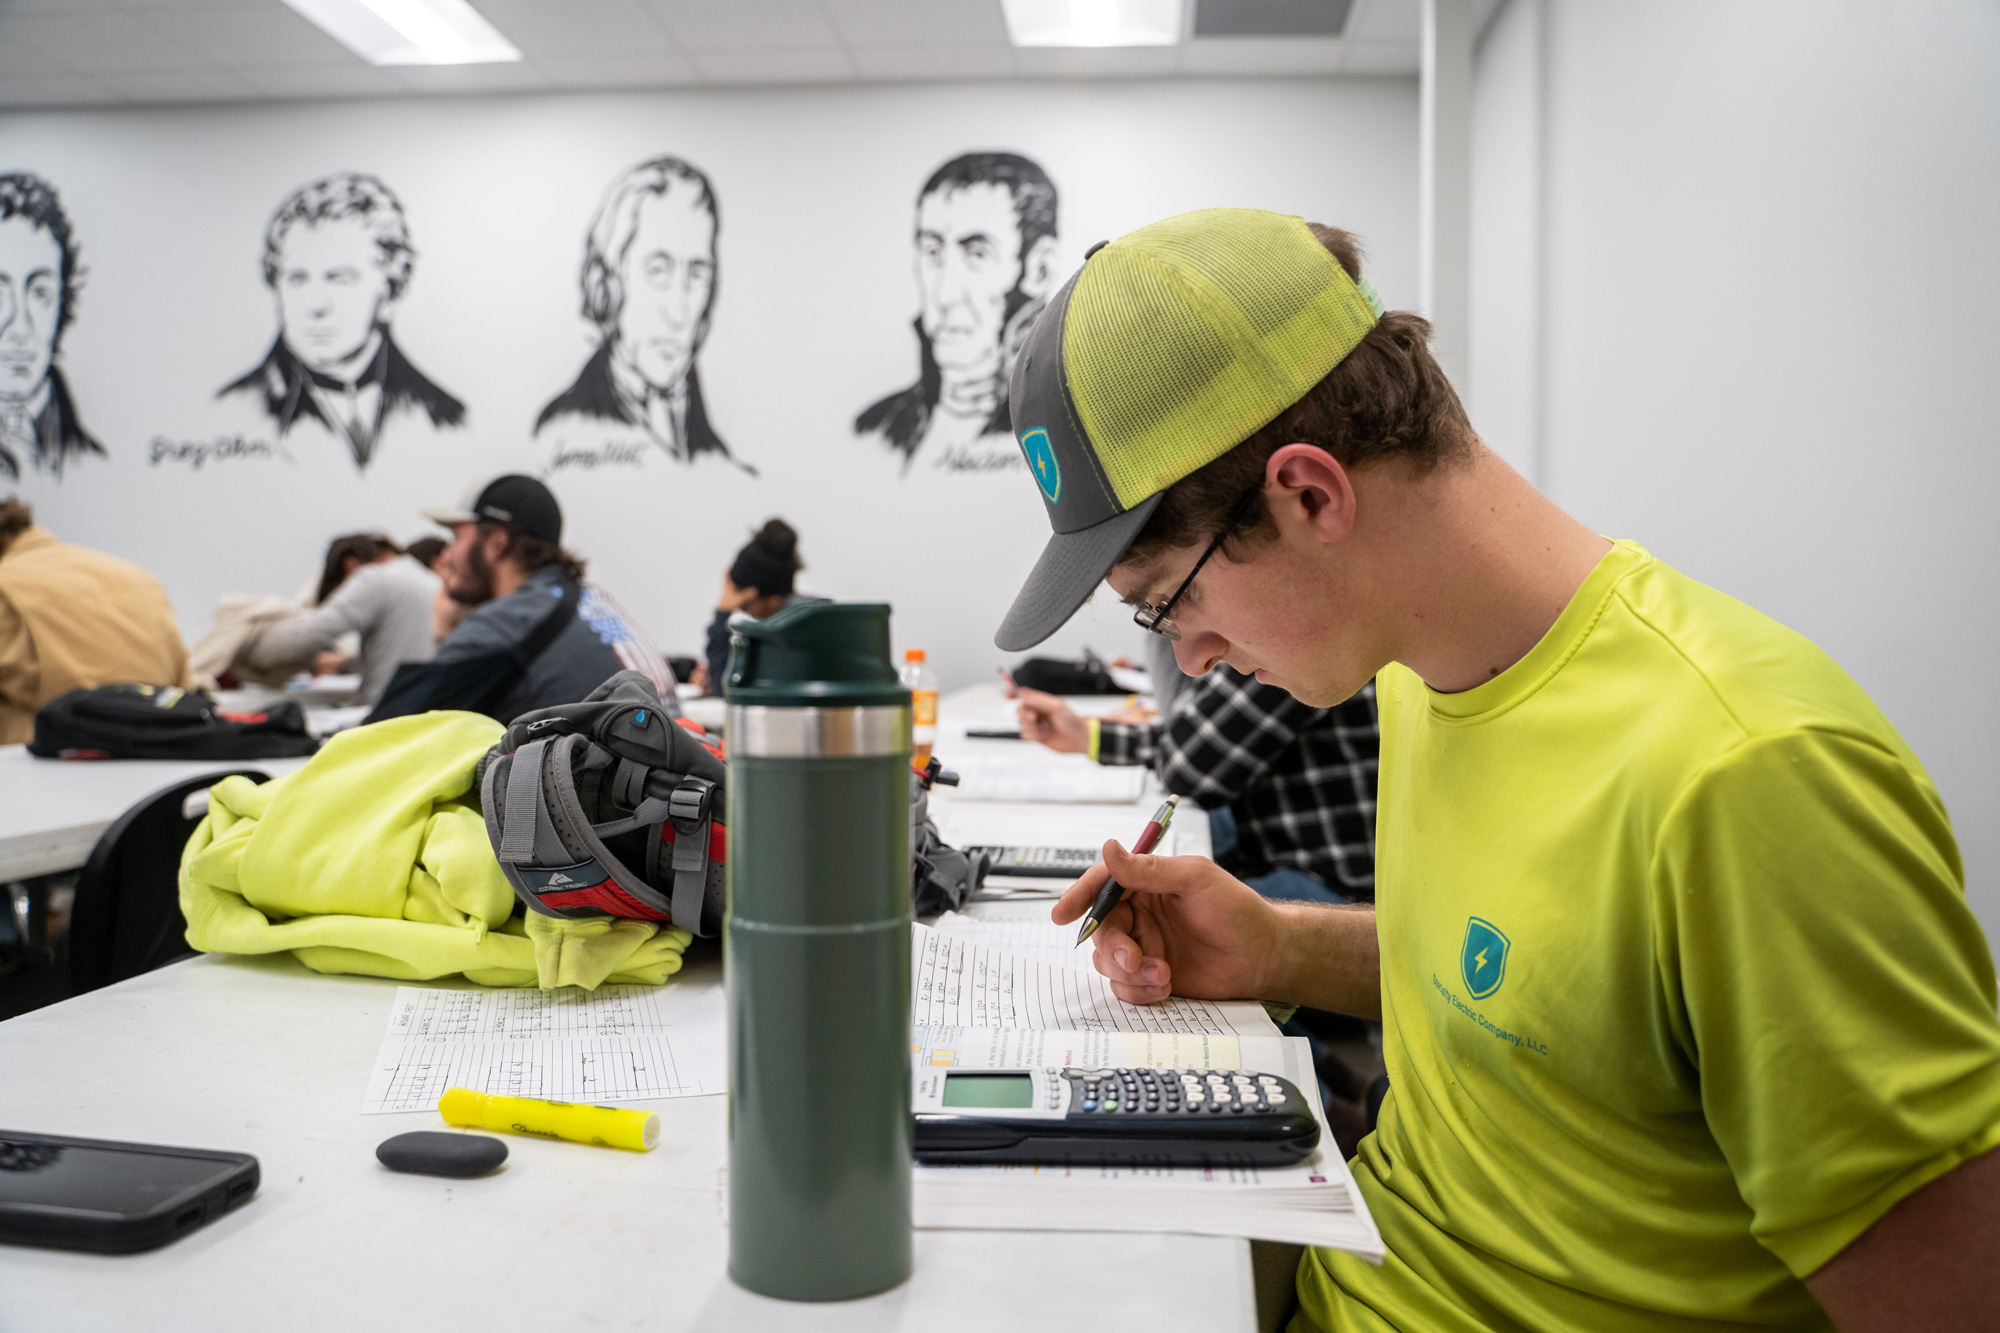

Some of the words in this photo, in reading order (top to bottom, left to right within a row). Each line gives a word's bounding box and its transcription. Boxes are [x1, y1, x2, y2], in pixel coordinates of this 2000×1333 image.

[1452, 994, 1477, 1021] Electric
[1478, 1014, 1524, 1047] Company,
[1527, 1036, 1548, 1056] LLC
